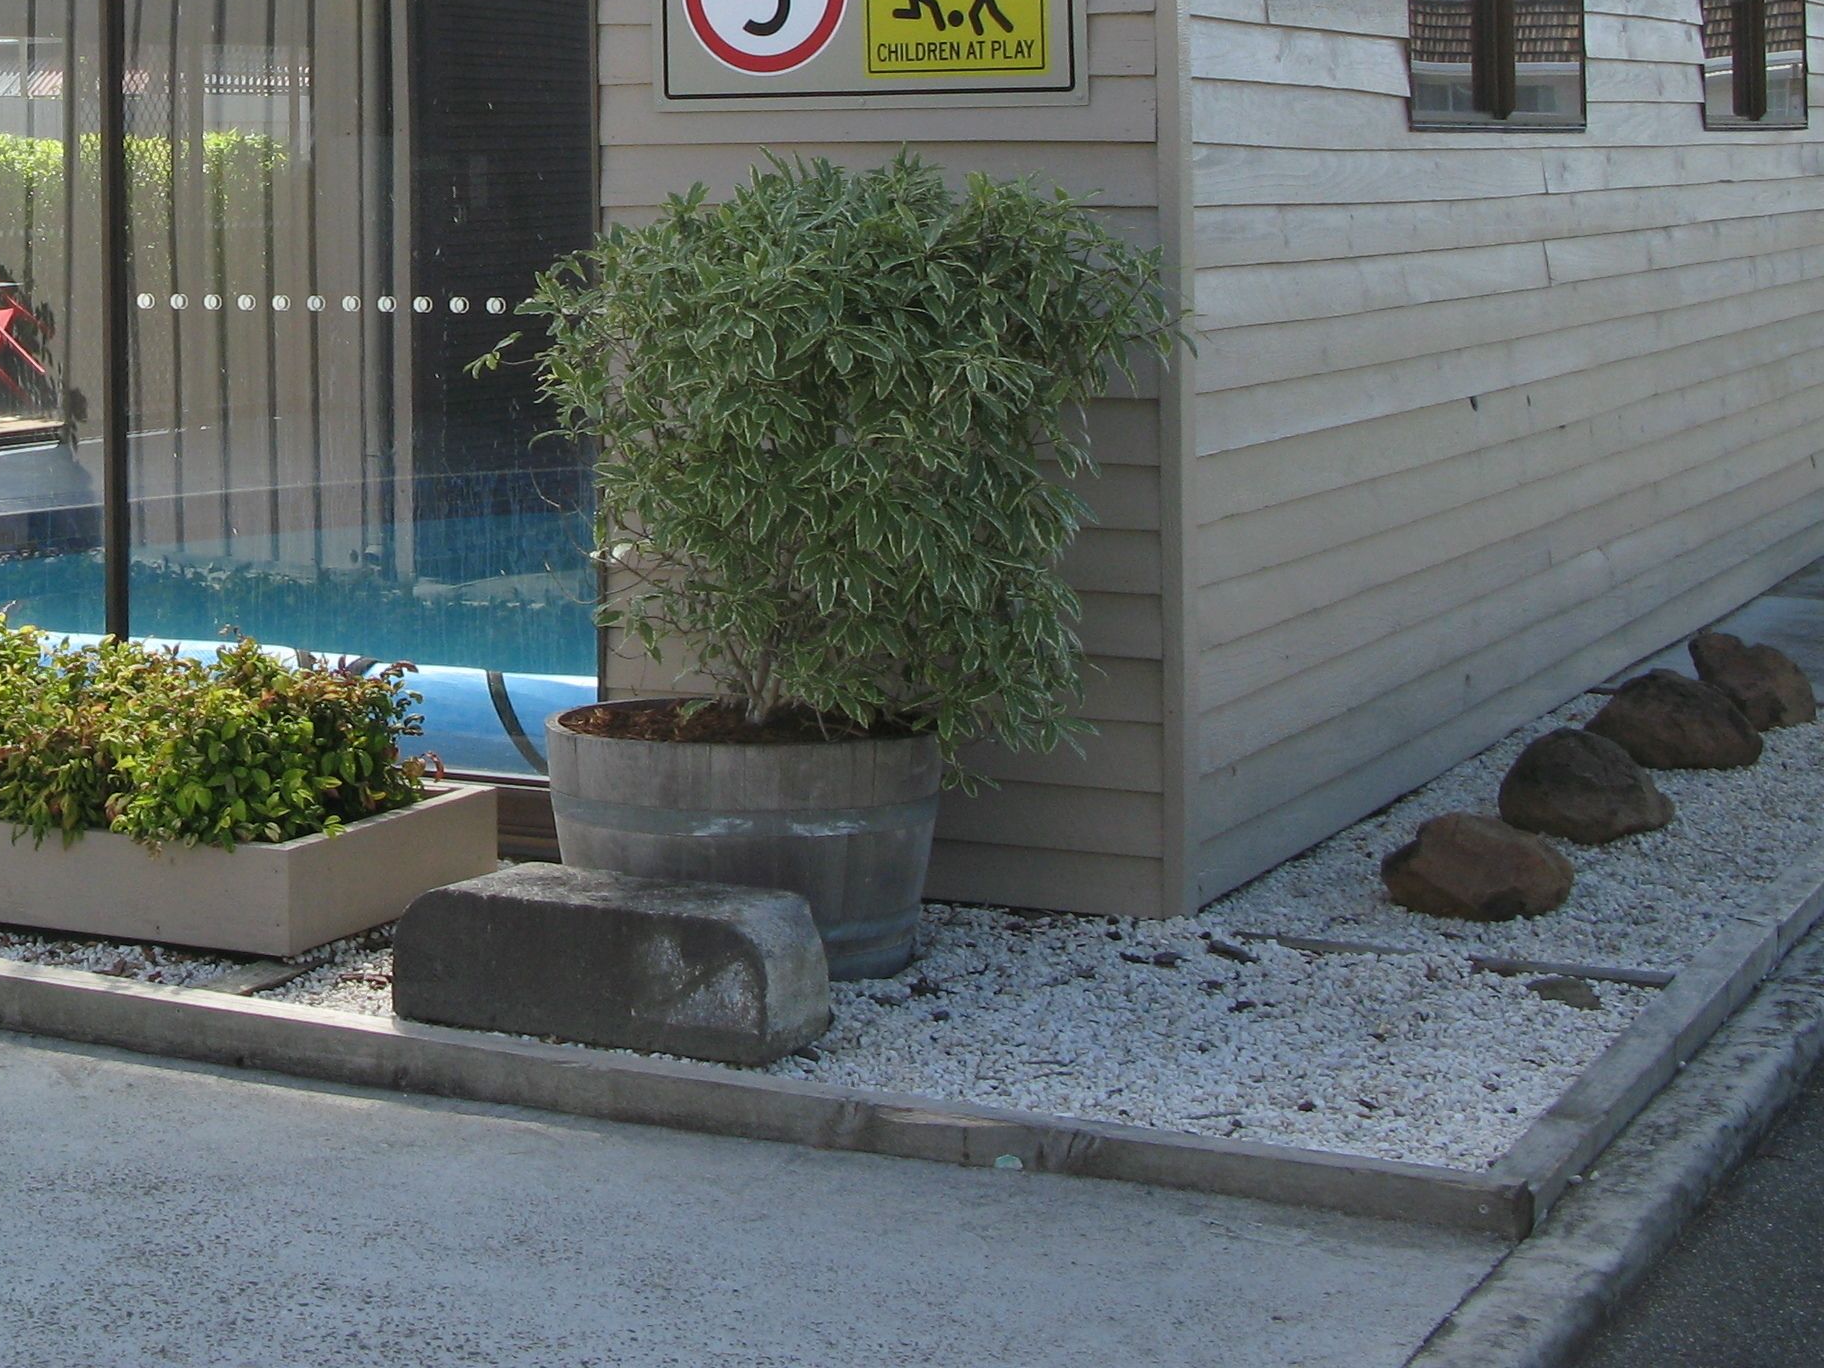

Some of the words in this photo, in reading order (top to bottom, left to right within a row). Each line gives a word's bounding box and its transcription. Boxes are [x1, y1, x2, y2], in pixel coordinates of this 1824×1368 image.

[876, 43, 961, 63] CHILDREN
[965, 41, 986, 61] AT
[991, 39, 1035, 60] PLAY
